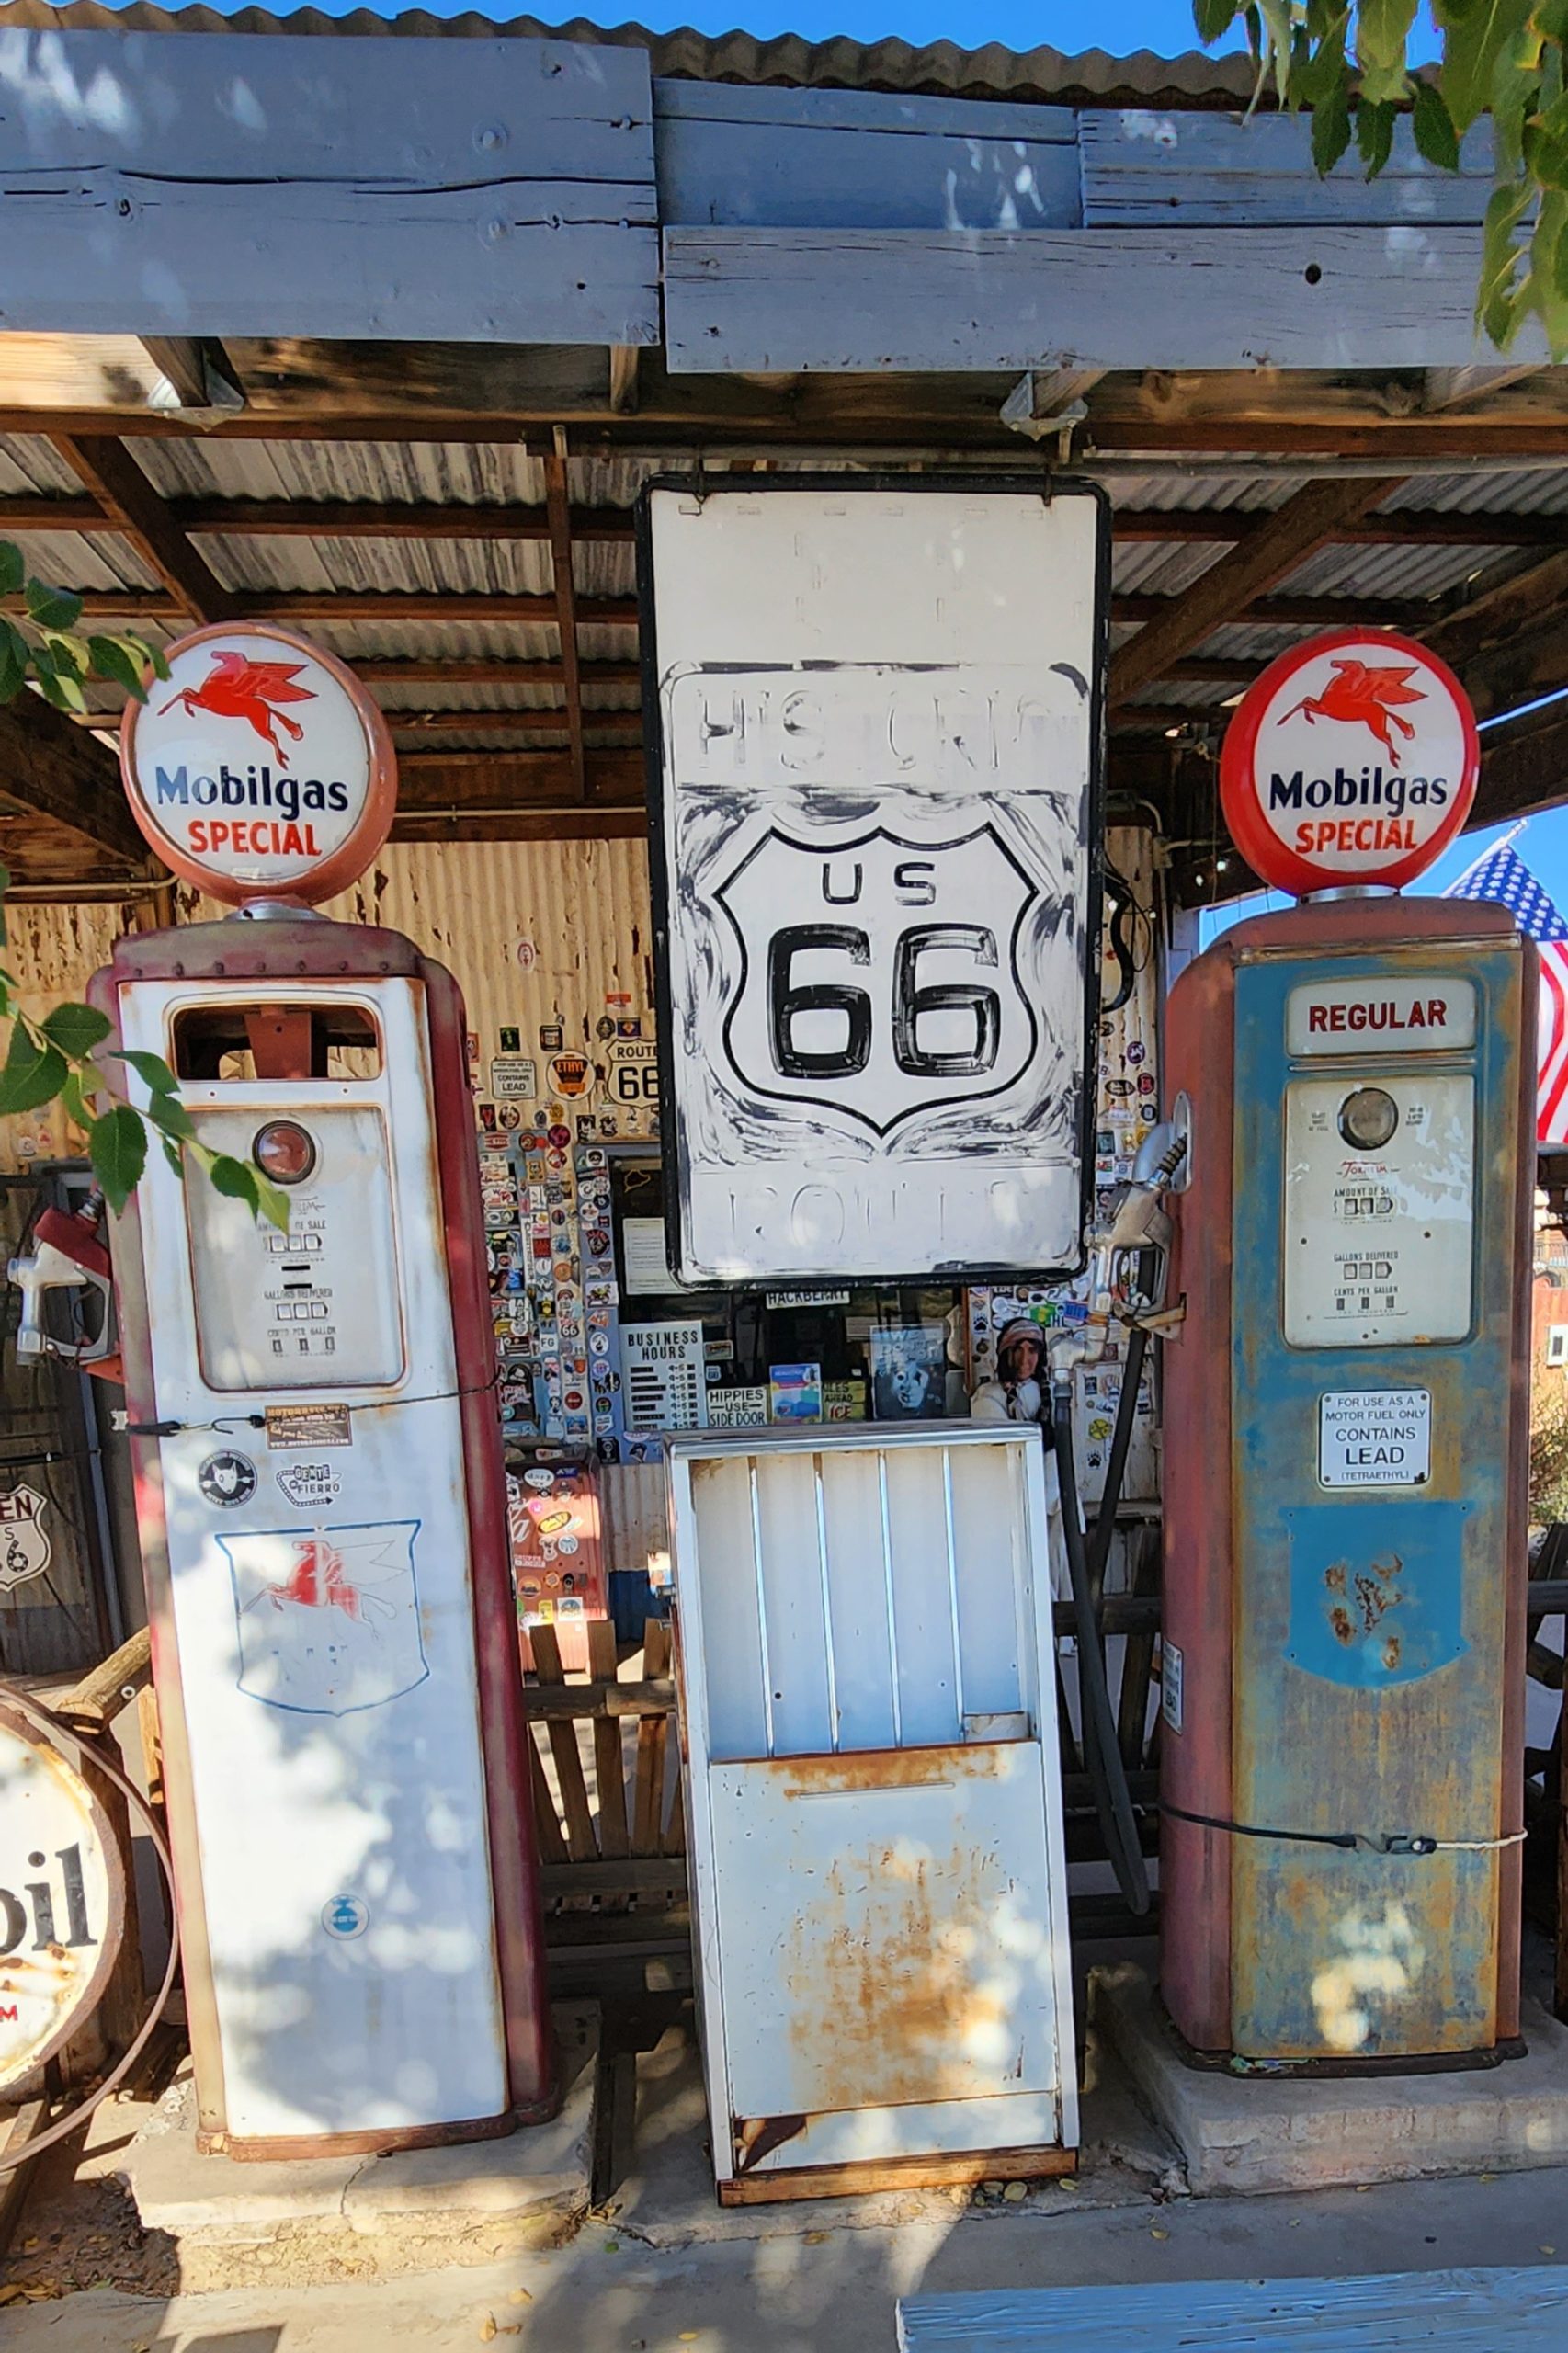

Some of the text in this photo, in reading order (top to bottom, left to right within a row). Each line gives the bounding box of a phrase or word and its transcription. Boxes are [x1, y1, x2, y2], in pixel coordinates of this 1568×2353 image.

[155, 765, 348, 821] Mobilgas
[1269, 767, 1447, 817] Mobilgas
[187, 820, 322, 856] SPECIAL
[1295, 819, 1417, 854] SPECIAL
[767, 923, 1000, 1079] 66
[1309, 999, 1447, 1032] REGULAR
[556, 1061, 585, 1073] ETHYL
[502, 1082, 527, 1092] LEAD
[618, 1066, 658, 1100] 66
[1334, 1187, 1367, 1198] AMOUNT
[1369, 1187, 1378, 1196] OF
[1334, 1251, 1398, 1263] GALLONS DELIVERED
[1334, 1286, 1398, 1297] CENTS PER GALLON
[628, 1331, 699, 1347] BUSINESS
[642, 1346, 686, 1361] HOURS
[710, 1389, 764, 1403] HIPPIES
[1337, 1396, 1415, 1407] FOR USE AS A
[725, 1402, 748, 1413] USE
[710, 1412, 765, 1427] SIDE DOOR
[1325, 1409, 1426, 1422] MOTOR FUEL ONLY
[1335, 1427, 1416, 1442] CONTAINS
[1346, 1447, 1405, 1465] LEAD
[293, 1464, 331, 1482] GENTE
[1341, 1471, 1409, 1481] (TETRAETHYL)
[297, 1483, 340, 1495] FIERRO
